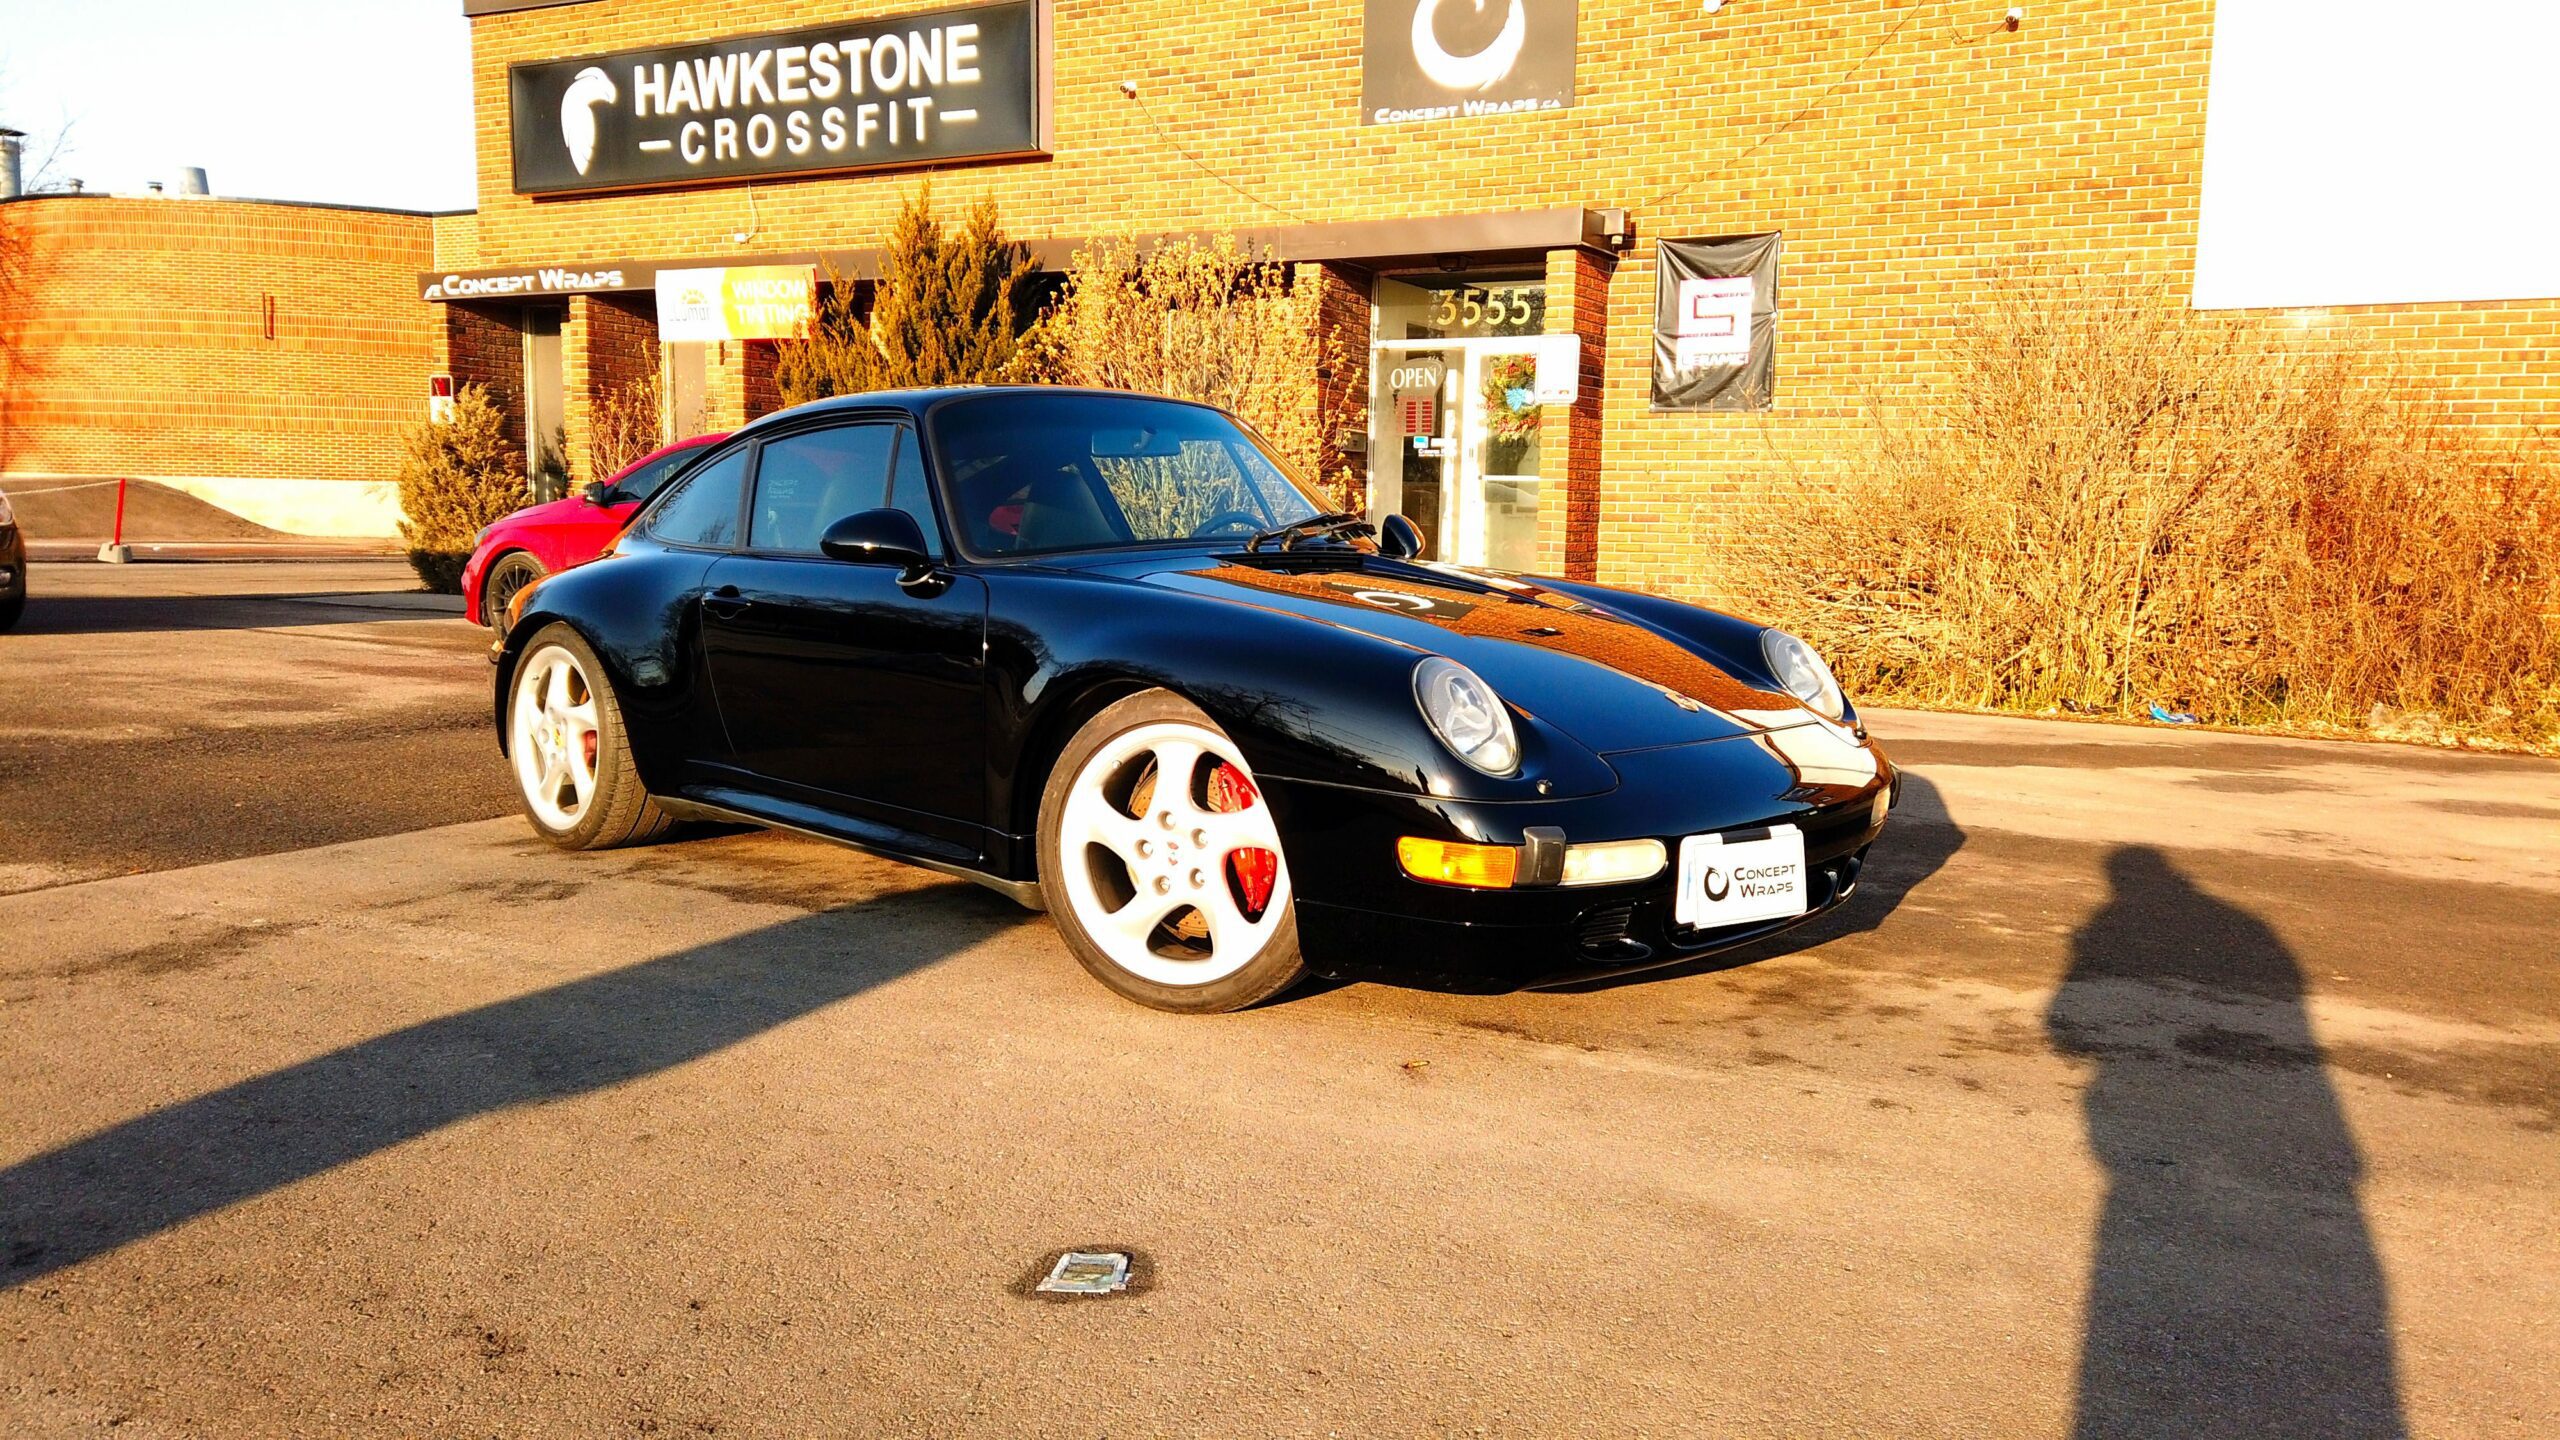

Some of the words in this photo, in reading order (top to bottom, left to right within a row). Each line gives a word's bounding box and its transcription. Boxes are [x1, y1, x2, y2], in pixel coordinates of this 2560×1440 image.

[634, 23, 981, 116] HAWKESTONE
[1374, 105, 1459, 123] CONCEPT
[1463, 98, 1538, 116] WRAPS
[679, 96, 932, 165] CROSSFIT
[443, 275, 535, 296] CONCEPT
[538, 269, 625, 290] WRAPS
[1436, 288, 1532, 326] 3555
[1390, 367, 1437, 389] OPEN
[1734, 864, 1796, 881] CONCEPT
[1740, 881, 1793, 898] WRAPS
